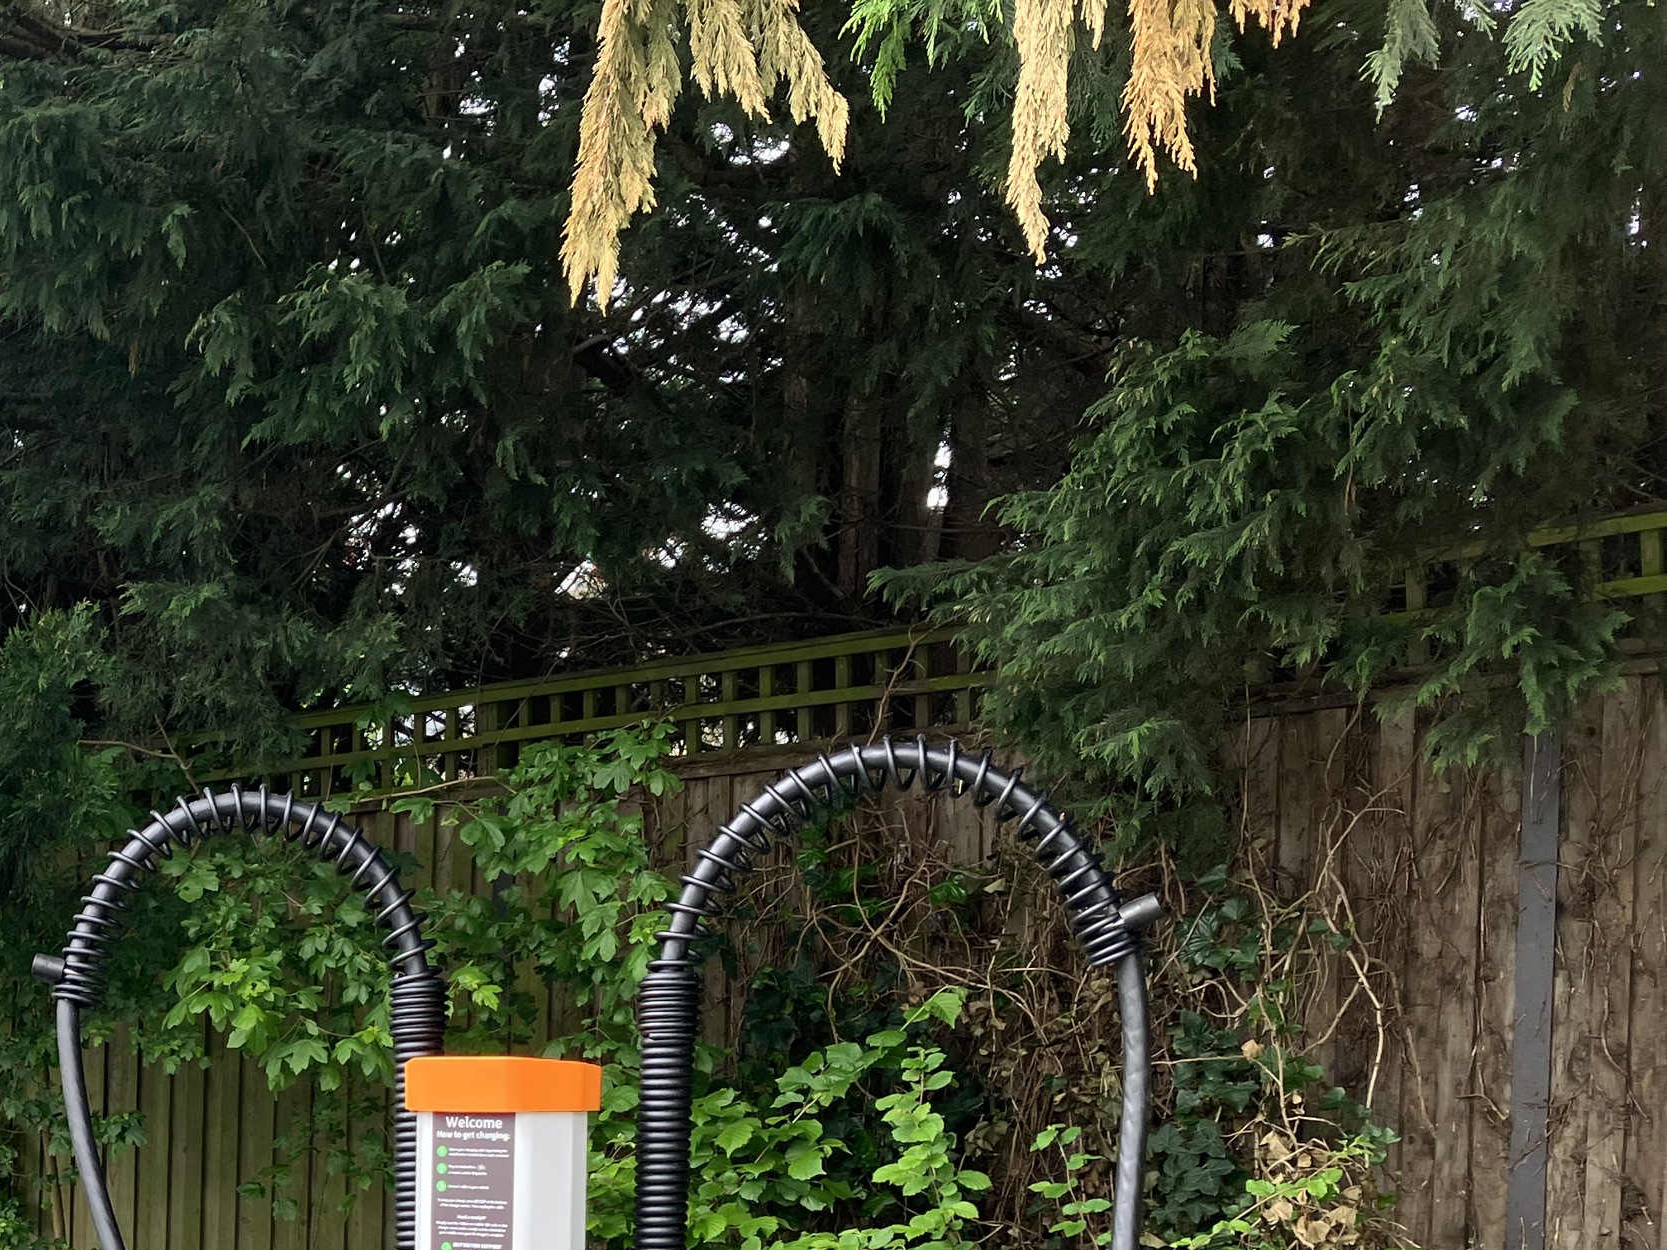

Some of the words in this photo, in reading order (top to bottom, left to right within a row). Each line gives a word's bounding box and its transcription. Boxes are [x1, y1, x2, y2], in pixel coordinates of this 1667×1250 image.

[445, 1116, 502, 1129] Welcome
[436, 1130, 453, 1138] How
[463, 1131, 474, 1140] get
[476, 1131, 510, 1141] charging:
